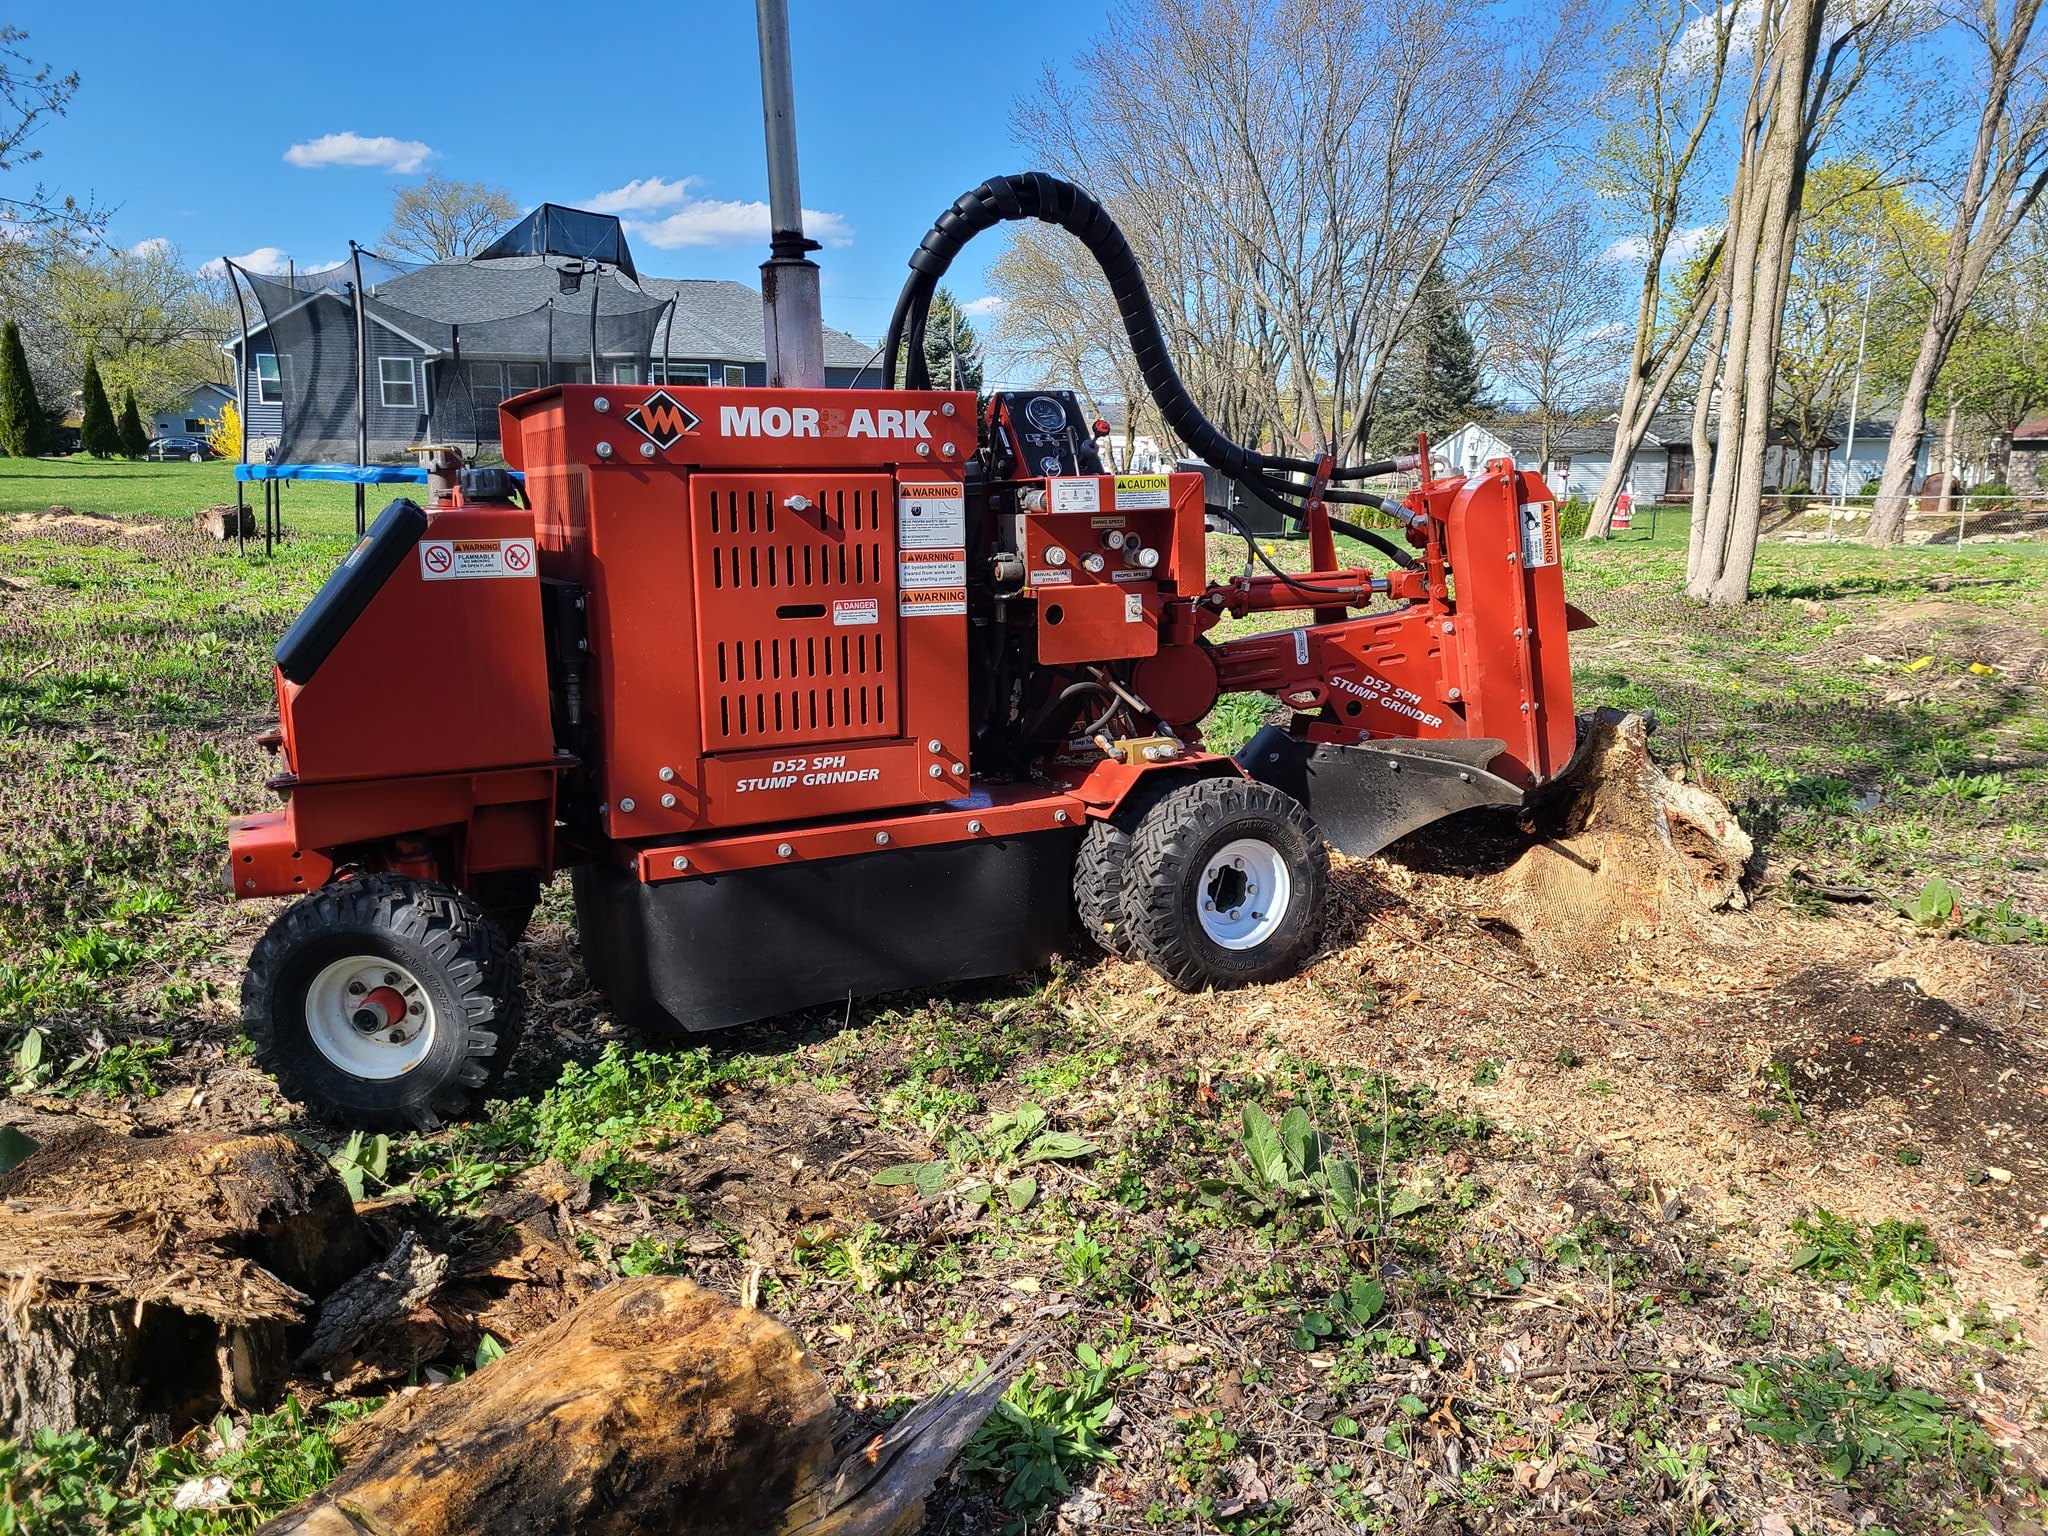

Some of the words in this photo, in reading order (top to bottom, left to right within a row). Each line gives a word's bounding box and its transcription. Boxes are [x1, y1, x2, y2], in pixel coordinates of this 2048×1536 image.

[1127, 479, 1166, 489] CAUTION
[912, 487, 959, 497] WARNING
[1543, 514, 1554, 563] WARNING
[462, 543, 501, 552] WARNING!
[914, 553, 955, 561] WARNING
[913, 592, 965, 602] WARNING
[843, 601, 875, 610] DANGER
[1362, 675, 1392, 693] D52
[1392, 688, 1422, 705] SPH
[1330, 676, 1379, 701] STUMP
[1380, 697, 1443, 728] GRINDER
[772, 759, 807, 773] D52
[811, 755, 846, 770] SPH
[735, 775, 798, 793] STUMP
[802, 768, 880, 786] GRINDER
